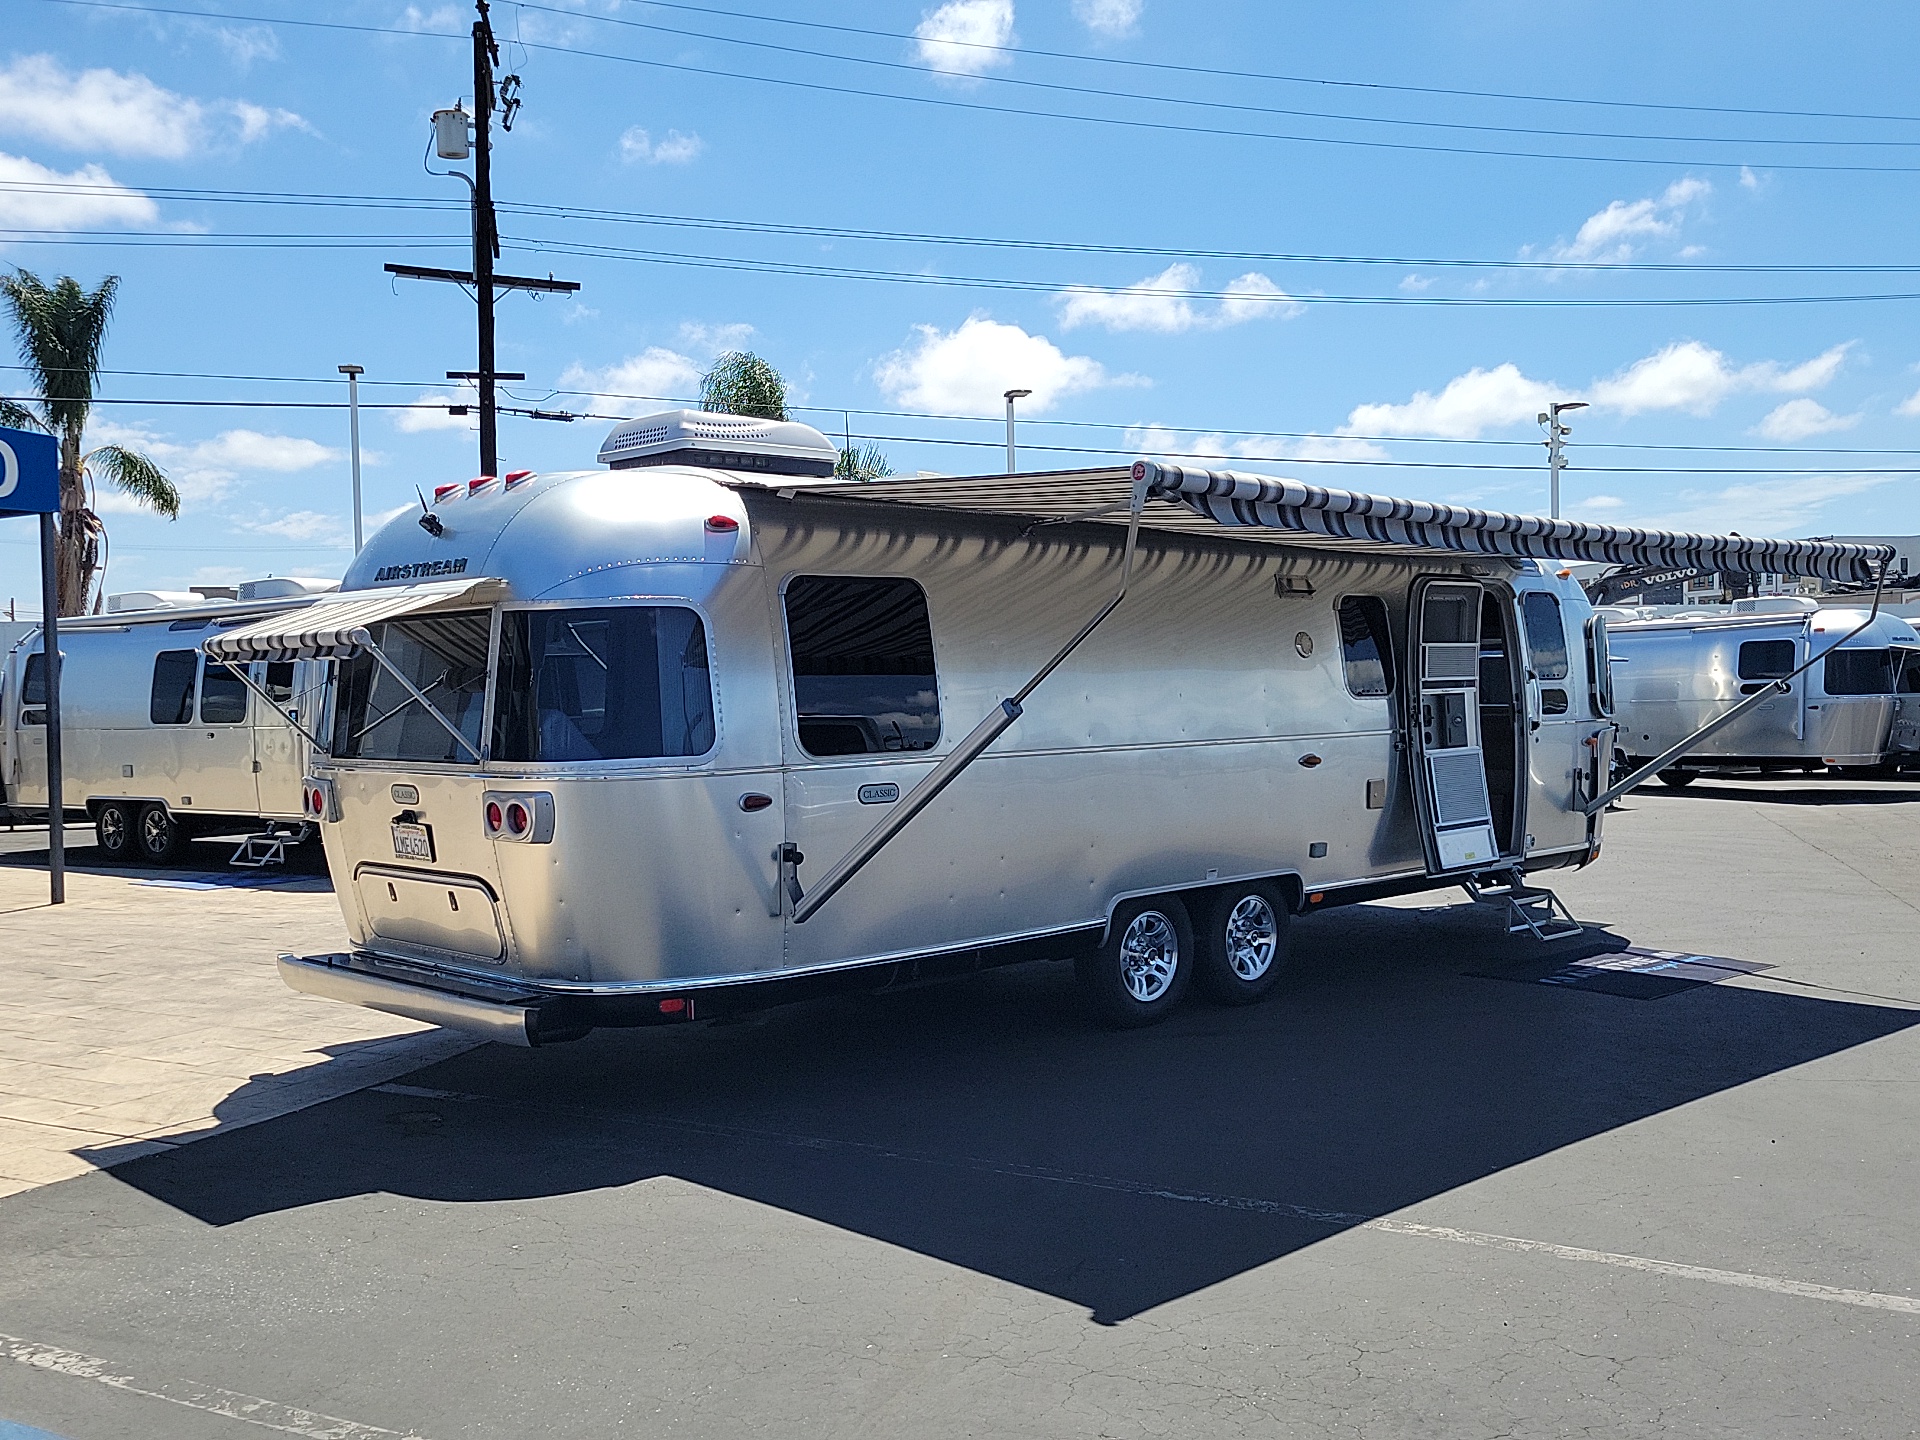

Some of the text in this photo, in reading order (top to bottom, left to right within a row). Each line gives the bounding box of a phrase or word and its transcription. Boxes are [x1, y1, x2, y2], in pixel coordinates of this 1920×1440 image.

[374, 557, 468, 581] AIRSTREAM
[1641, 567, 1698, 585] VOLVO
[863, 788, 896, 799] CLASSIC
